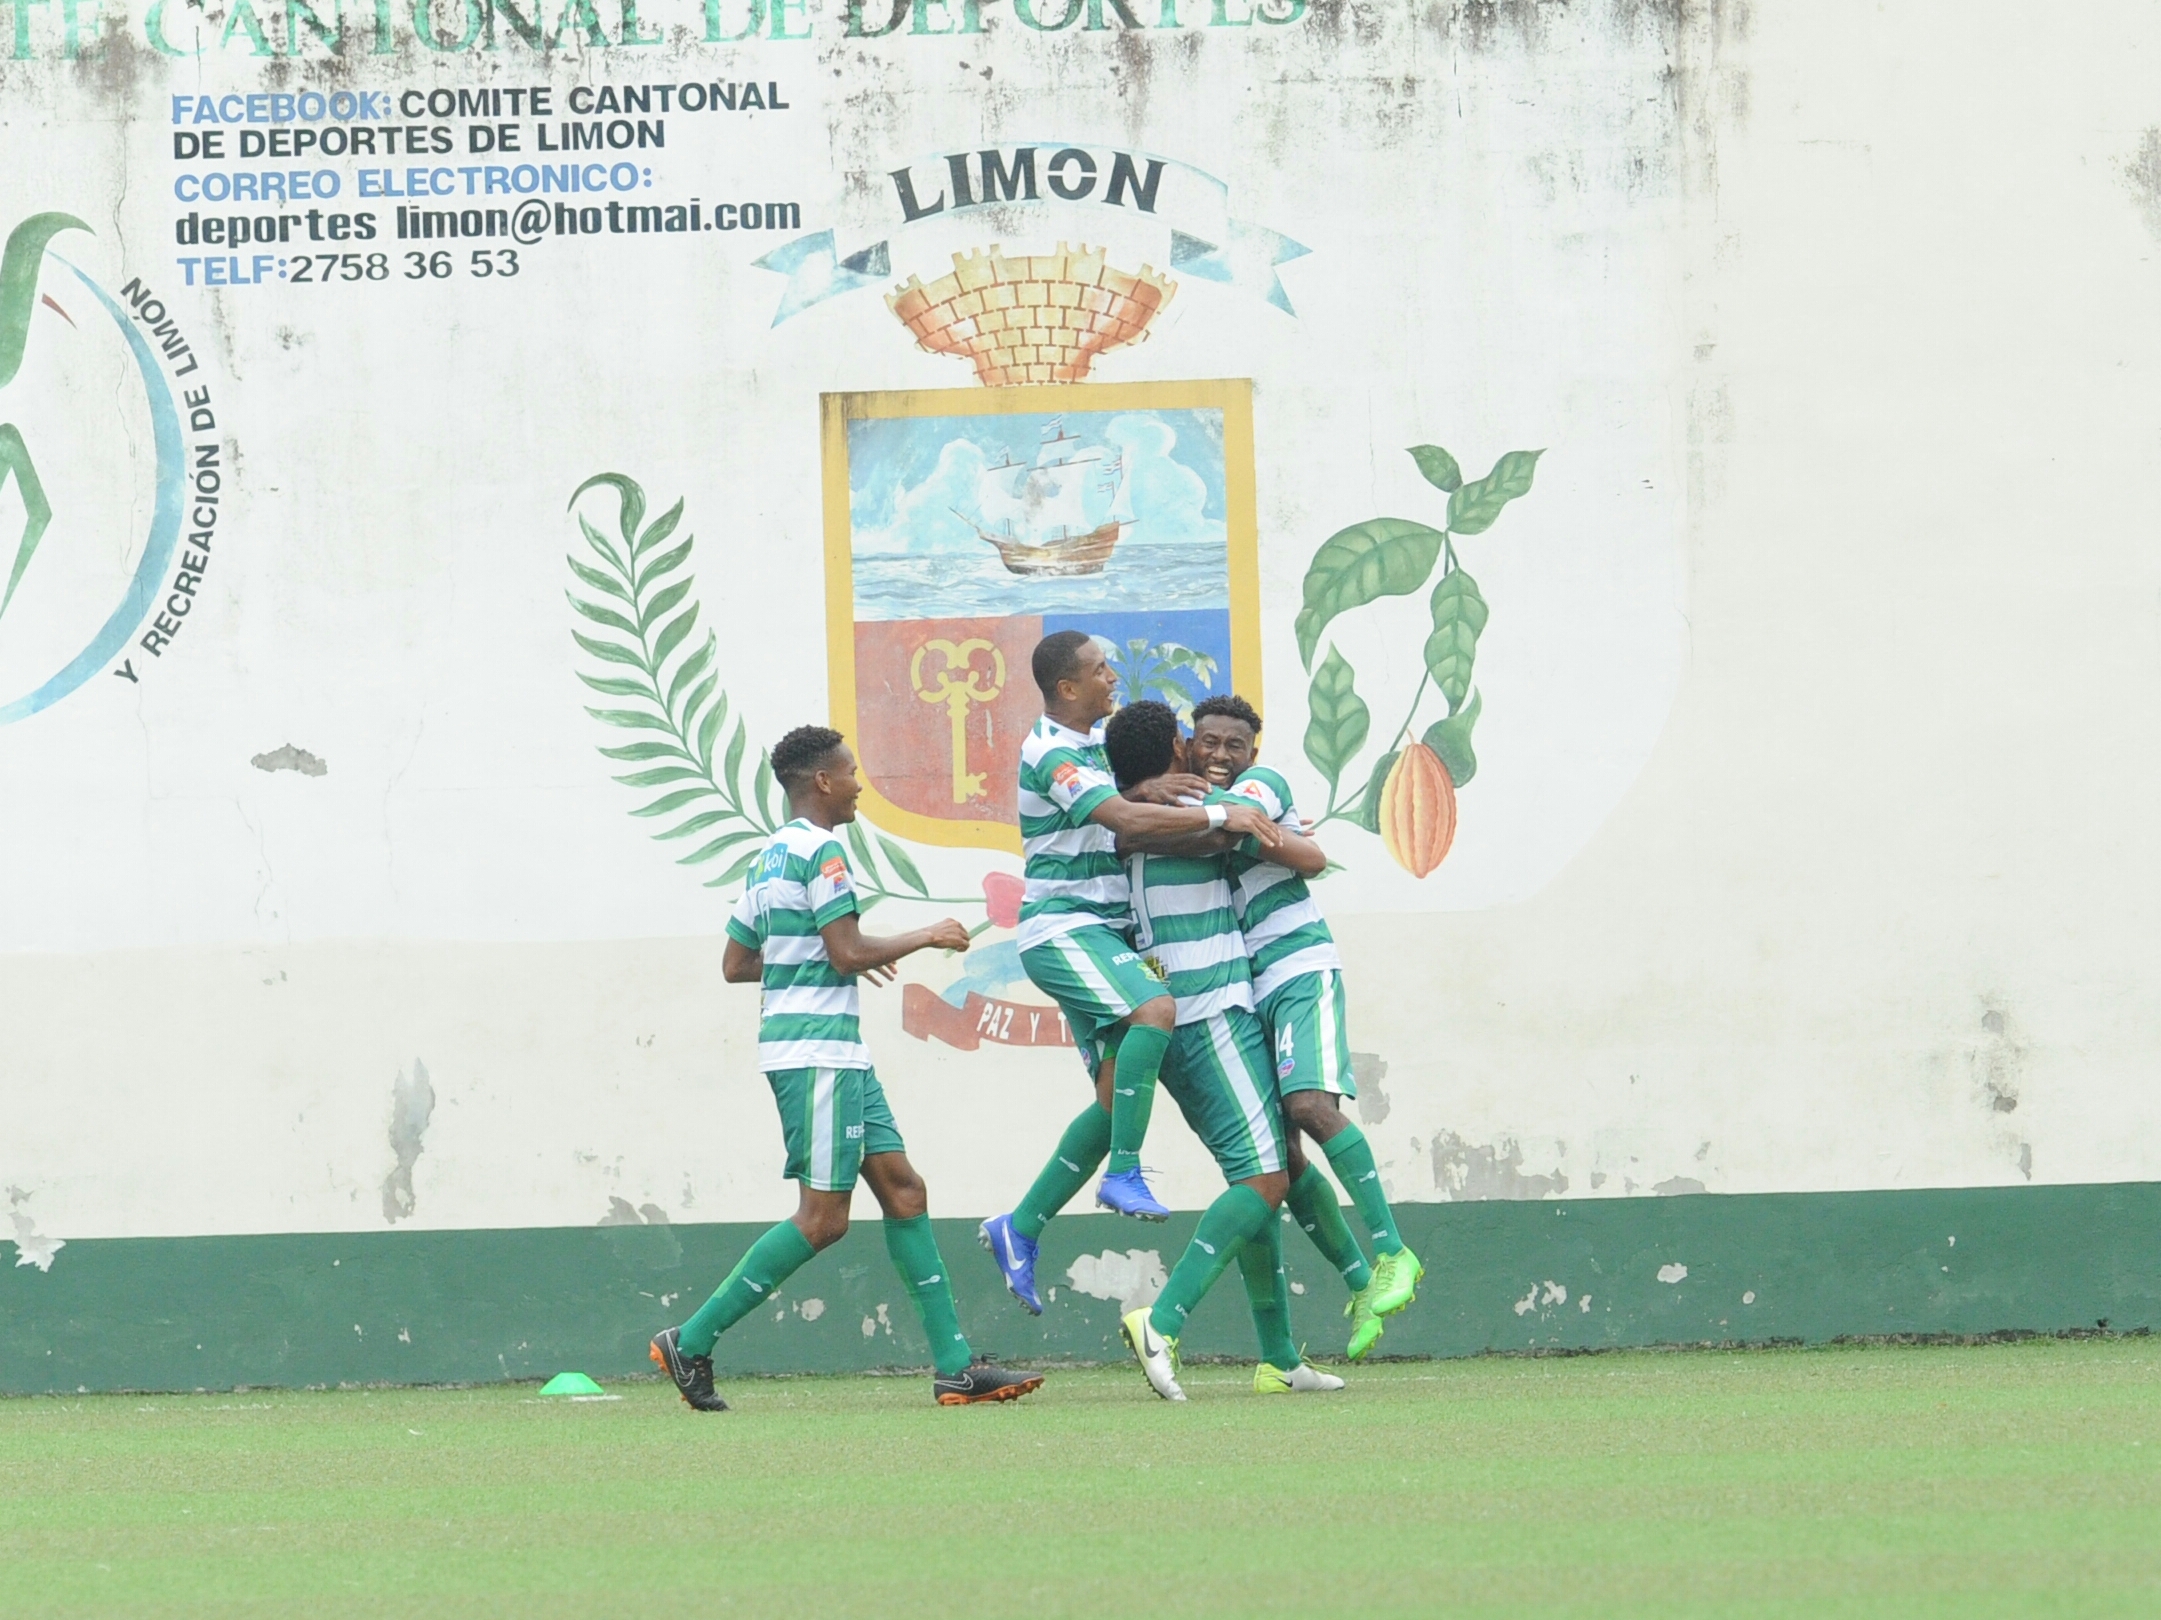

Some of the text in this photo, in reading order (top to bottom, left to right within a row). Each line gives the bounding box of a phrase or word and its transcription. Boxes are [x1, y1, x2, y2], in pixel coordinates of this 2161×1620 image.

[145, 0, 665, 57] CANTONAL
[701, 0, 813, 43] DE
[172, 81, 790, 125] FACEBOOK: COMITE CANTONAL
[173, 119, 665, 160] DE DEPORTES DE LIMON
[174, 161, 653, 202] CORREO ELECTRONICO:
[889, 146, 1169, 224] LIMON
[175, 211, 377, 249] deportes
[403, 250, 453, 279] 36
[470, 248, 520, 278] 53
[113, 276, 222, 685] Y RECREACIÓN DE LIMÓN
[976, 1001, 1015, 1040] PAZ
[1029, 1012, 1041, 1043] Y
